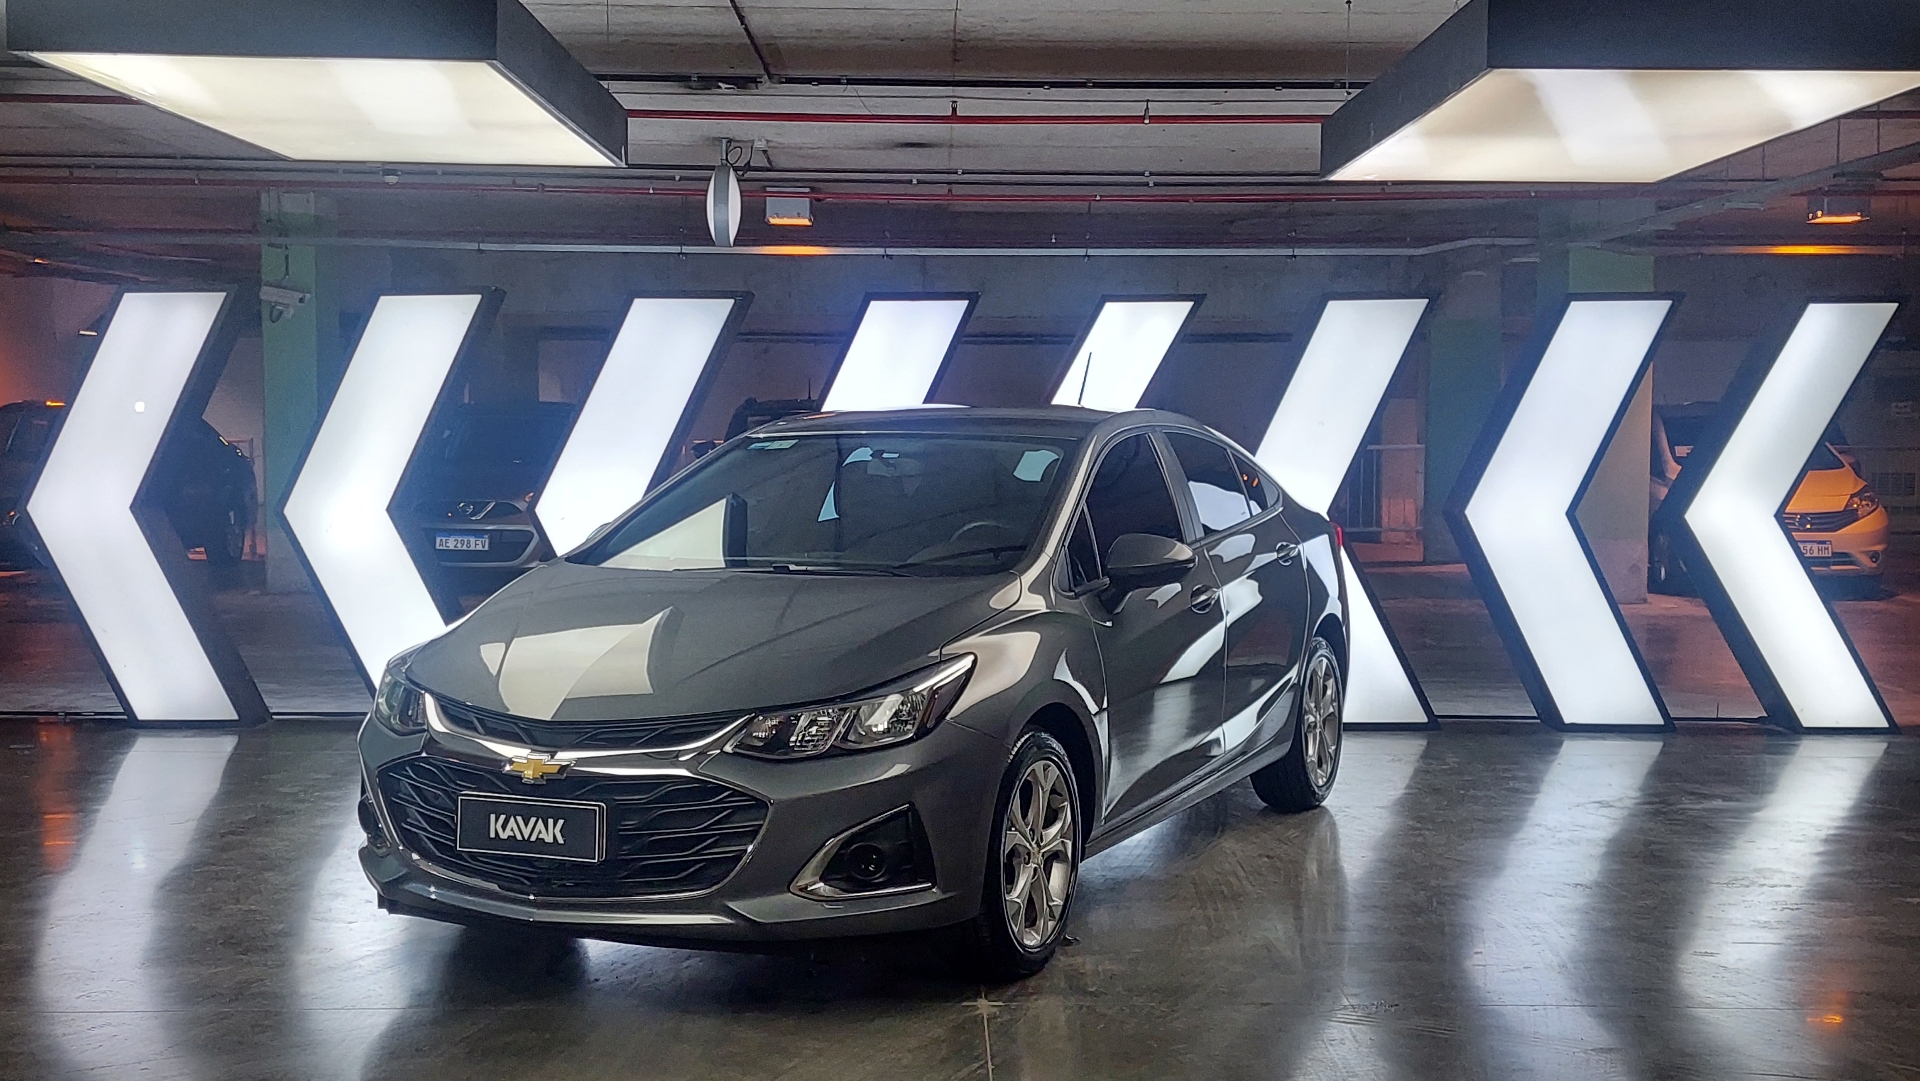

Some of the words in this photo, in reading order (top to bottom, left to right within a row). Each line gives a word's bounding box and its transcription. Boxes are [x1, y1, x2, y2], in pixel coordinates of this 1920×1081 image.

[438, 538, 450, 548] AE
[453, 538, 472, 549] 298
[474, 539, 487, 549] FV
[1817, 545, 1830, 555] HM
[489, 813, 565, 845] KAVAK
